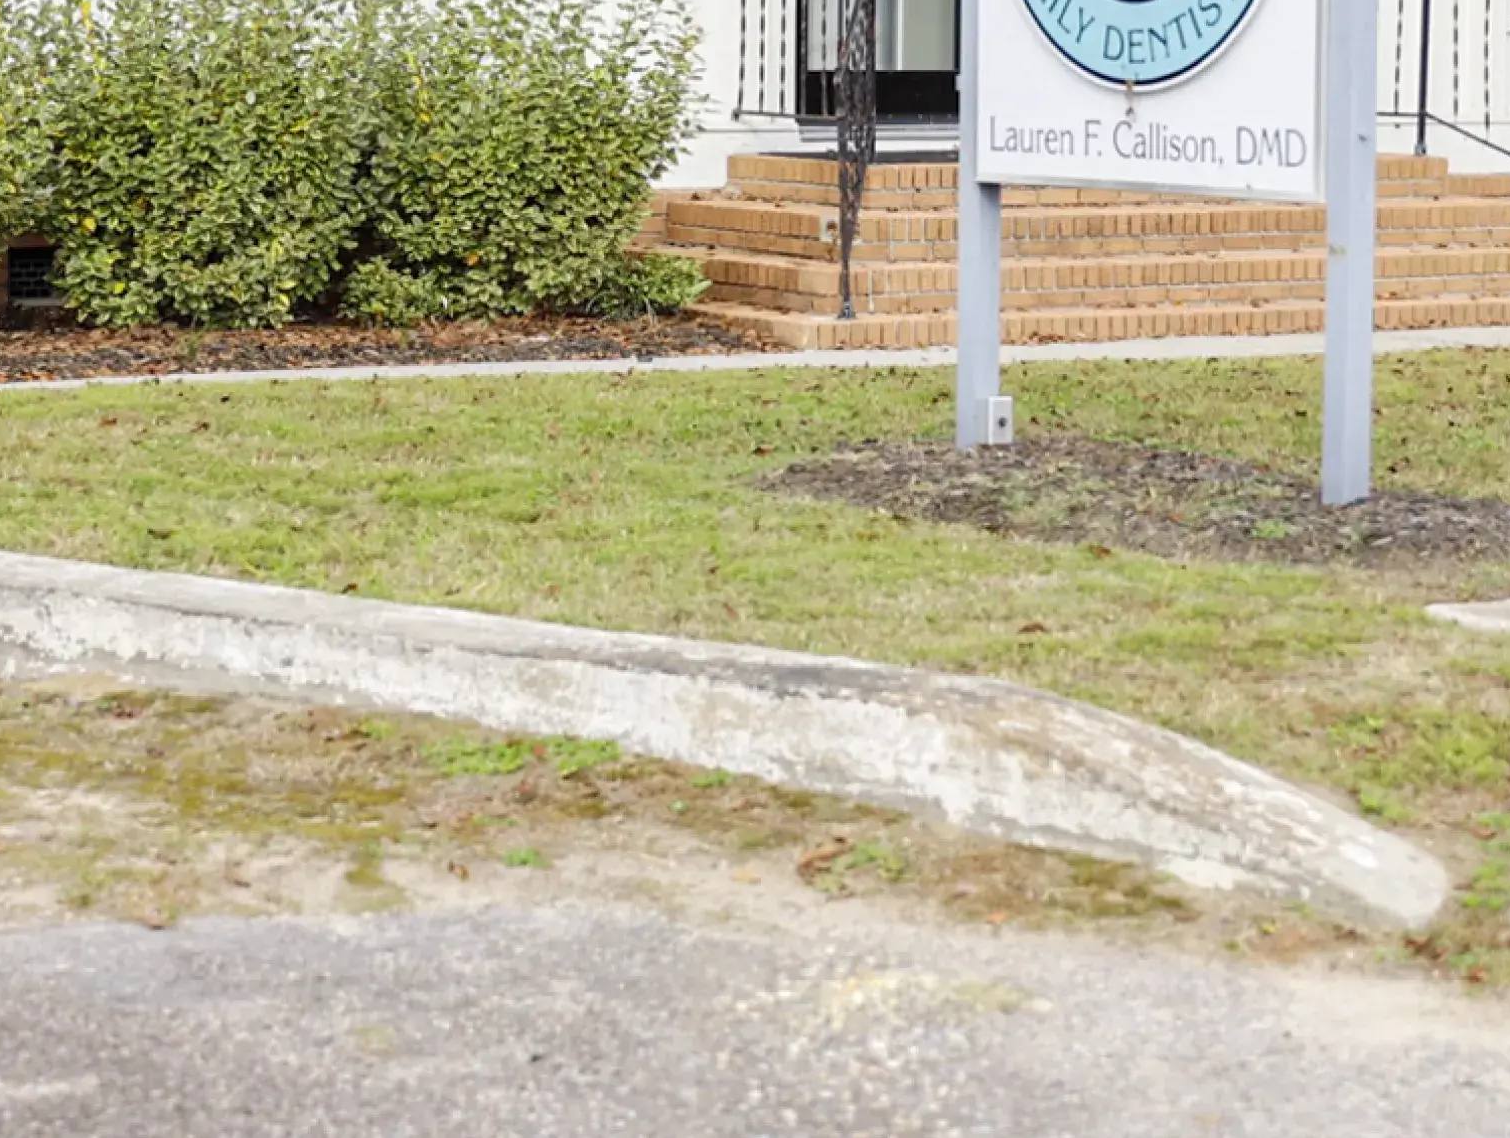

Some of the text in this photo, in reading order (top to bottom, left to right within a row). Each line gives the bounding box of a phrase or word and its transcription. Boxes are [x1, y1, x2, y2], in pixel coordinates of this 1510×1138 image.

[989, 115, 1308, 168] Lauren F. Callison, DMD
